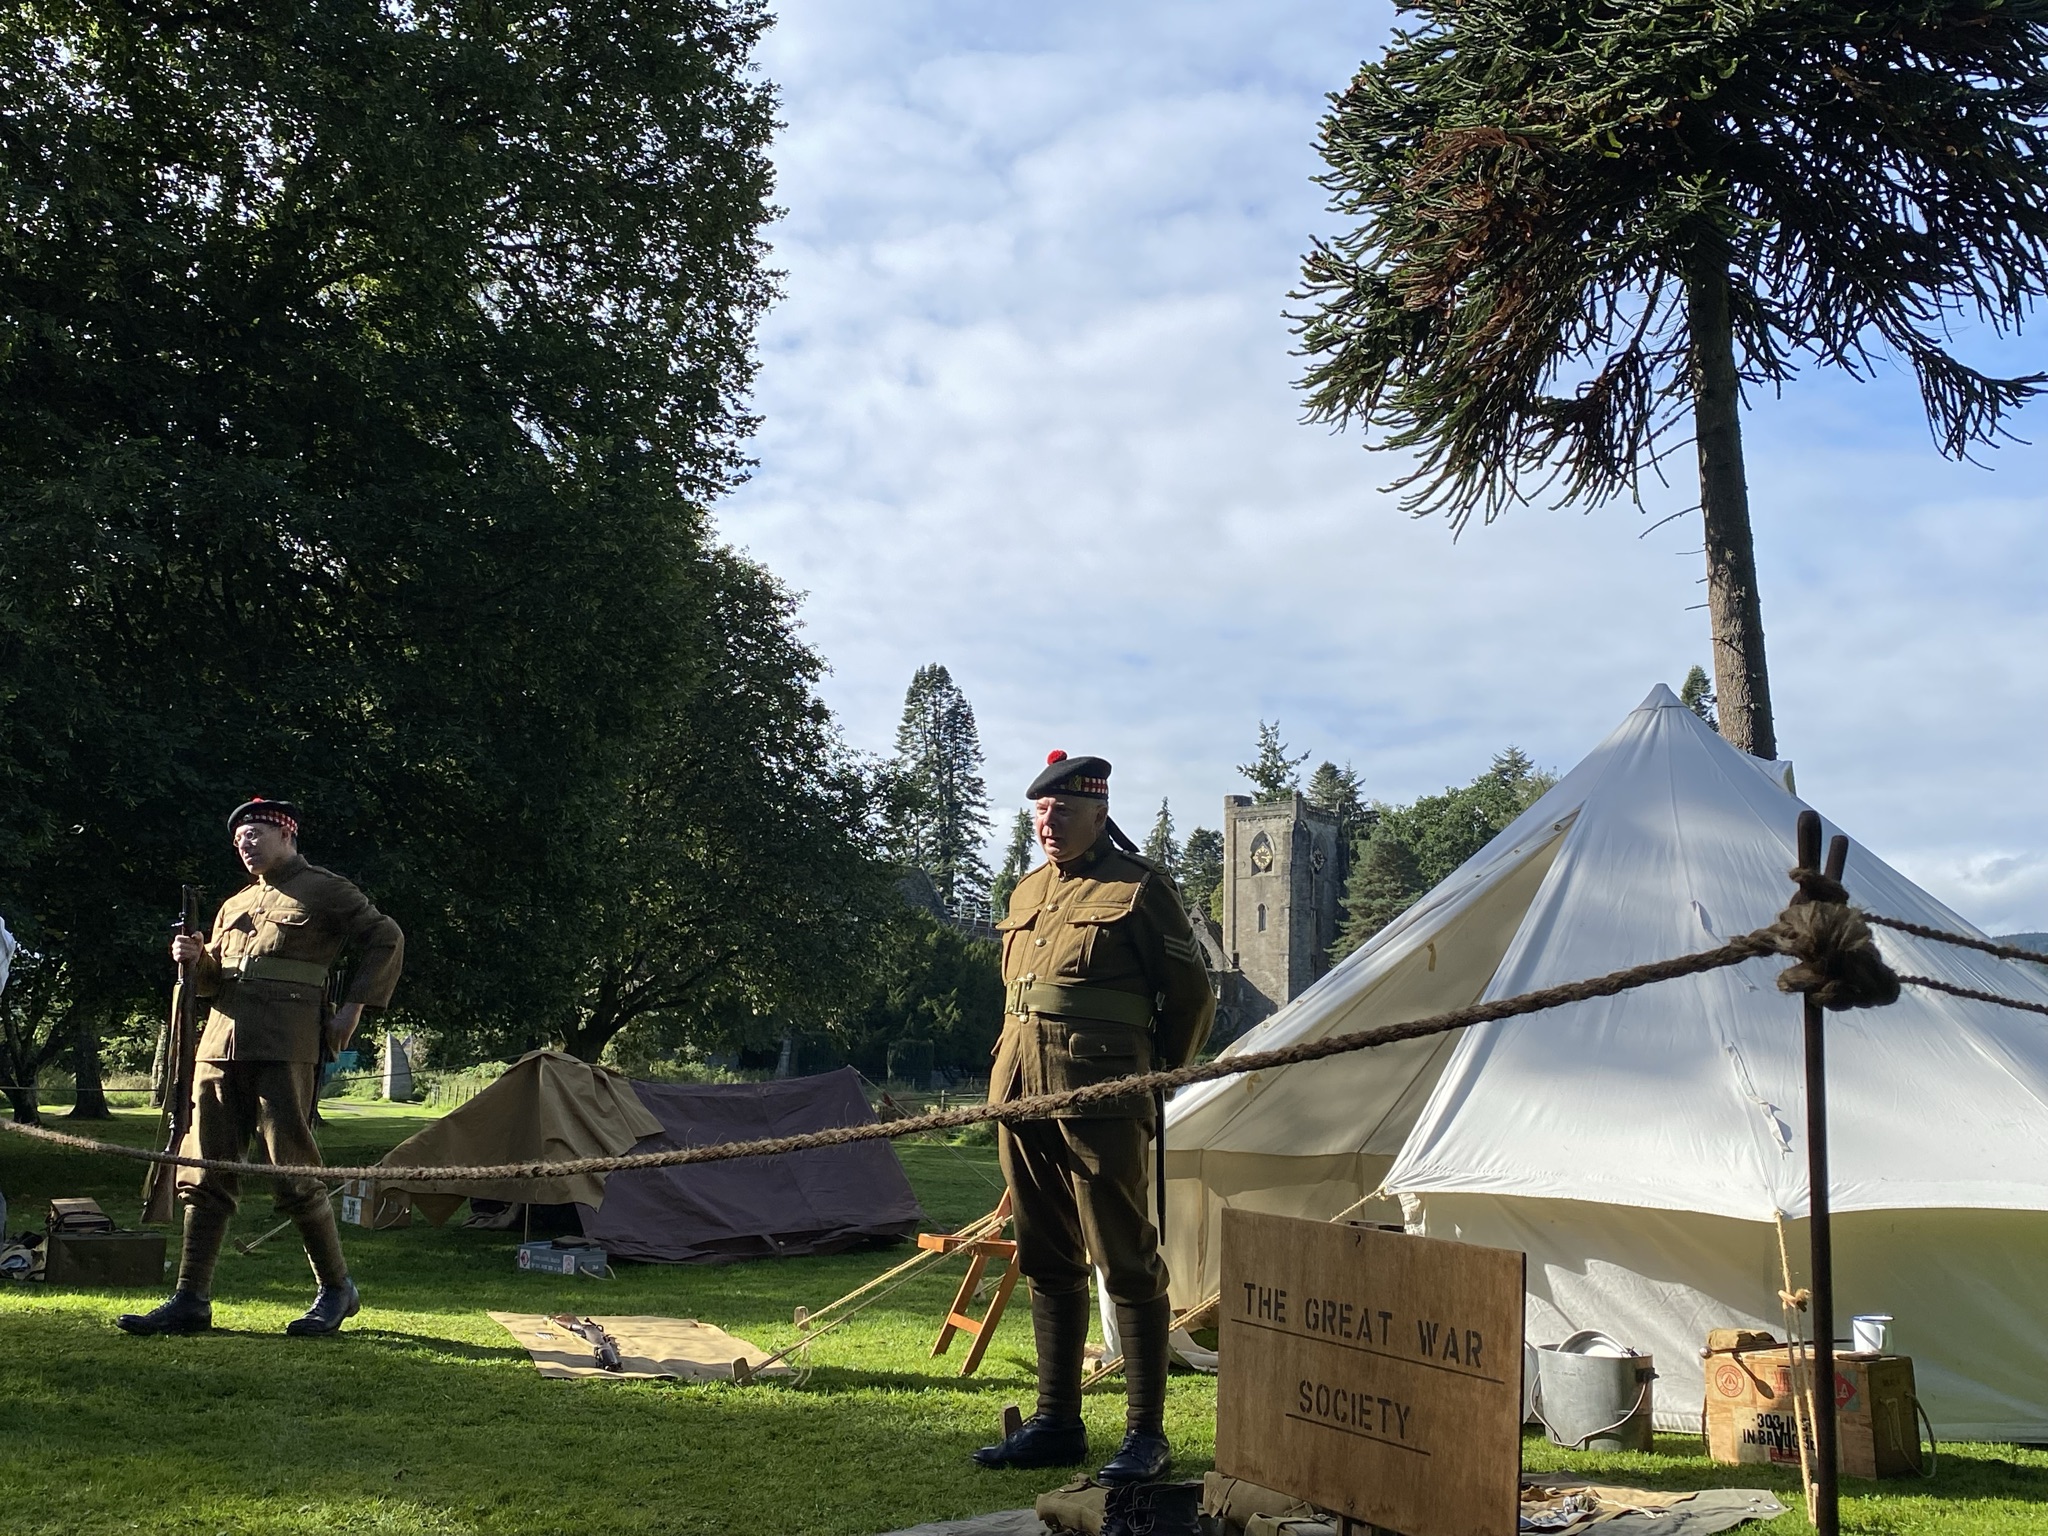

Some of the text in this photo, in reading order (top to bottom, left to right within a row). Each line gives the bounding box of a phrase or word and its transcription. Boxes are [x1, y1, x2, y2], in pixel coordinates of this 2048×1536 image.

[1243, 1282, 1484, 1369] THE GREAT WAR
[1298, 1379, 1411, 1440] SOCIETY
[1743, 1428, 1756, 1444] IN
